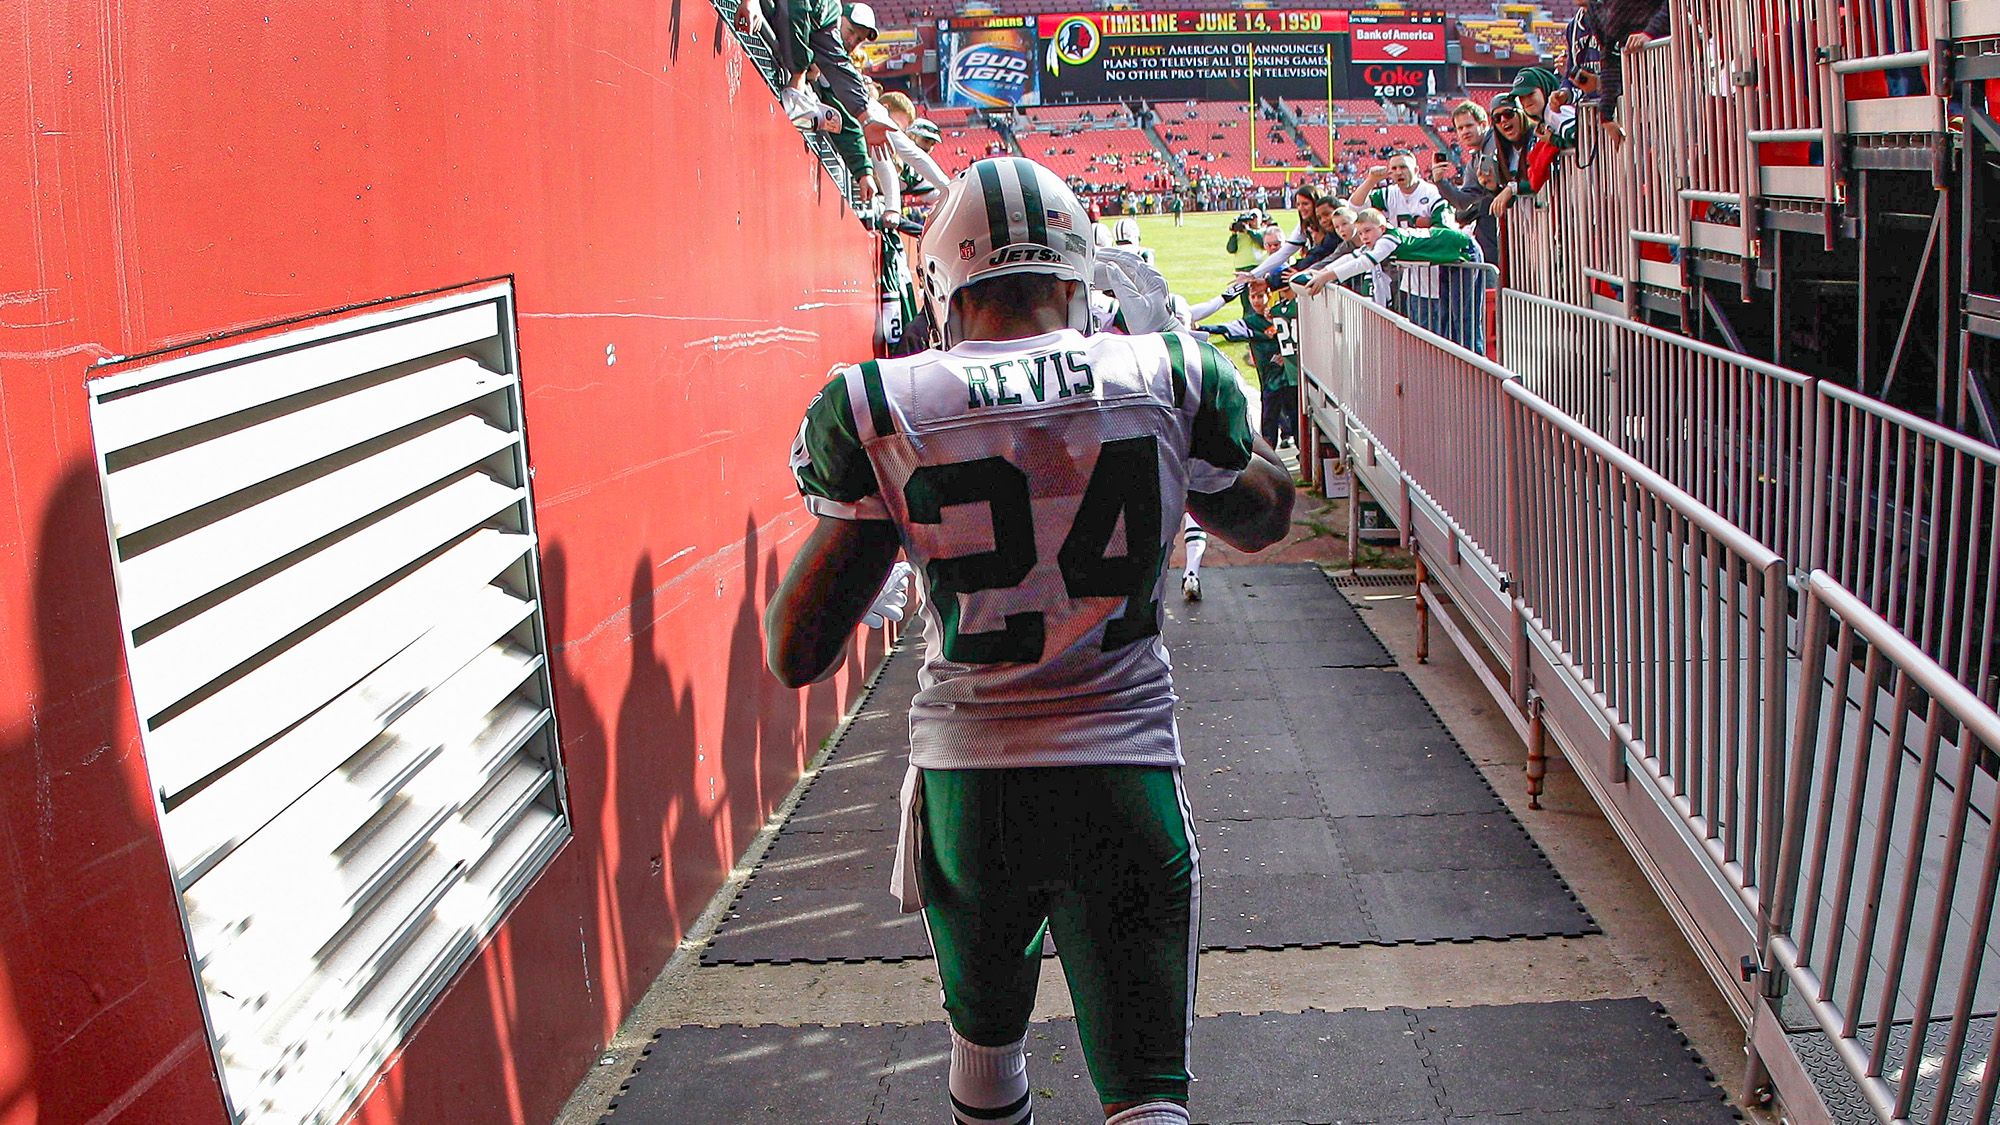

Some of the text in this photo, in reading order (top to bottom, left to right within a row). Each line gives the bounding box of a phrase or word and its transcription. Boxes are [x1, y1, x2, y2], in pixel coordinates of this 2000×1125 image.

[1100, 13, 1178, 33] TIMELINE
[1195, 12, 1237, 31] JUNE
[1244, 12, 1271, 33] 14,
[1278, 12, 1322, 31] 1950
[1356, 29, 1434, 40] Bank of America
[1109, 45, 1126, 57] TV
[1168, 44, 1228, 55] AMERICAN
[1254, 44, 1325, 54] ANNOUNCES
[965, 52, 1028, 72] BUD
[1103, 59, 1138, 69] PLANS
[1140, 58, 1158, 68] TO
[1160, 57, 1209, 67] TELEVISE
[1211, 57, 1231, 66] ALL
[957, 67, 1030, 85] LIGHT
[1105, 67, 1328, 81] NO OTHER PRO TEAM IS ON TELEVISION
[1363, 64, 1424, 86] Coke
[1373, 85, 1415, 97] zero
[989, 246, 1054, 266] JETS
[963, 350, 1095, 409] REVIS
[903, 434, 1167, 664] 24
